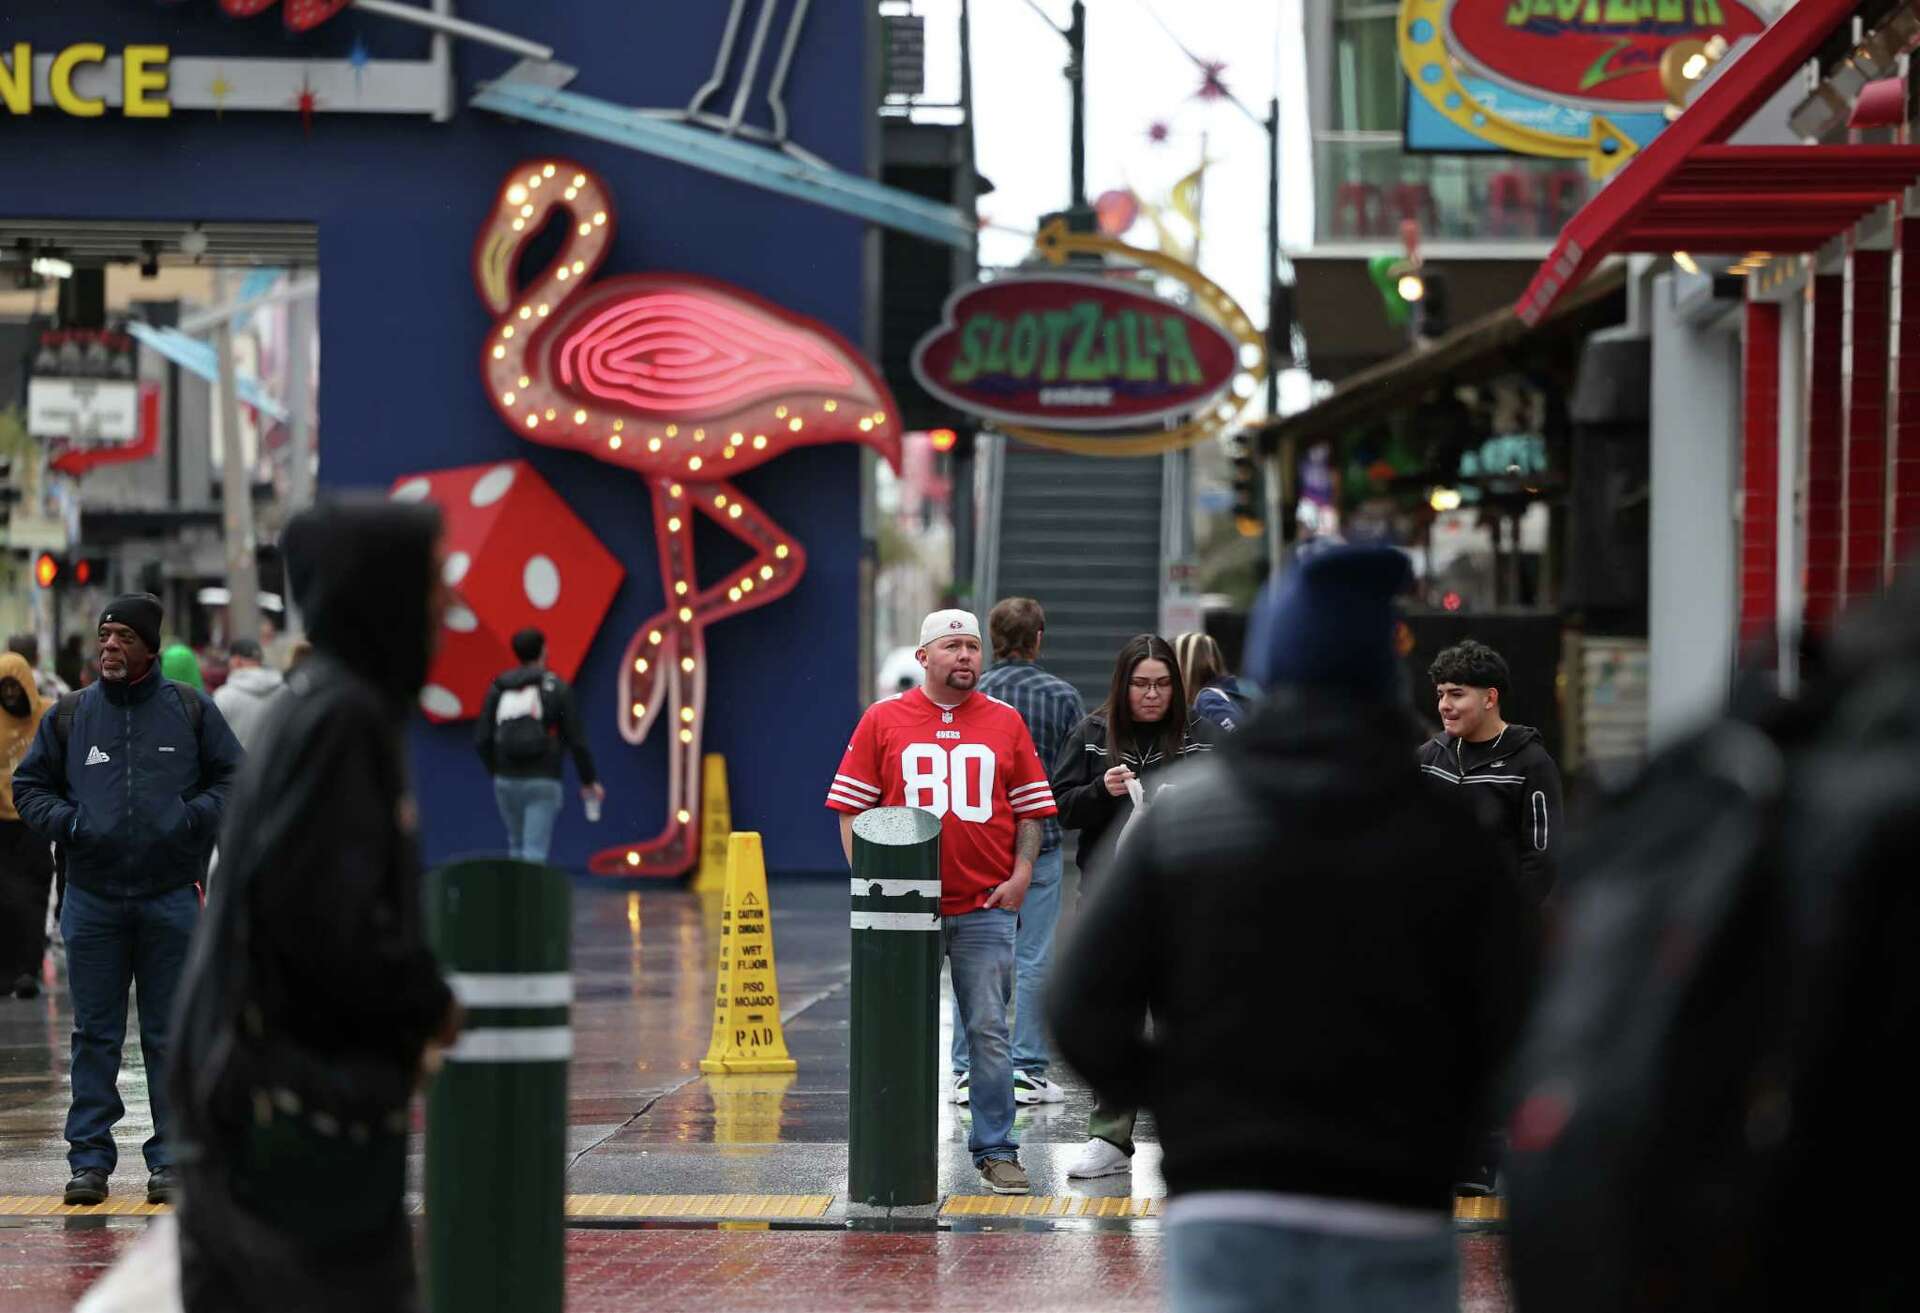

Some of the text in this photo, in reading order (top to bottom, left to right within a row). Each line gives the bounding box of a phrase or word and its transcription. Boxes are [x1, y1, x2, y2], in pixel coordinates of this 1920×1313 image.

[950, 301, 1203, 384] SLOTZILLA
[901, 743, 996, 824] 80
[737, 909, 764, 919] CAUTION
[742, 945, 762, 956] WET
[737, 959, 768, 970] FLOOR
[743, 982, 764, 992] PISO
[734, 995, 775, 1007] MOJADO
